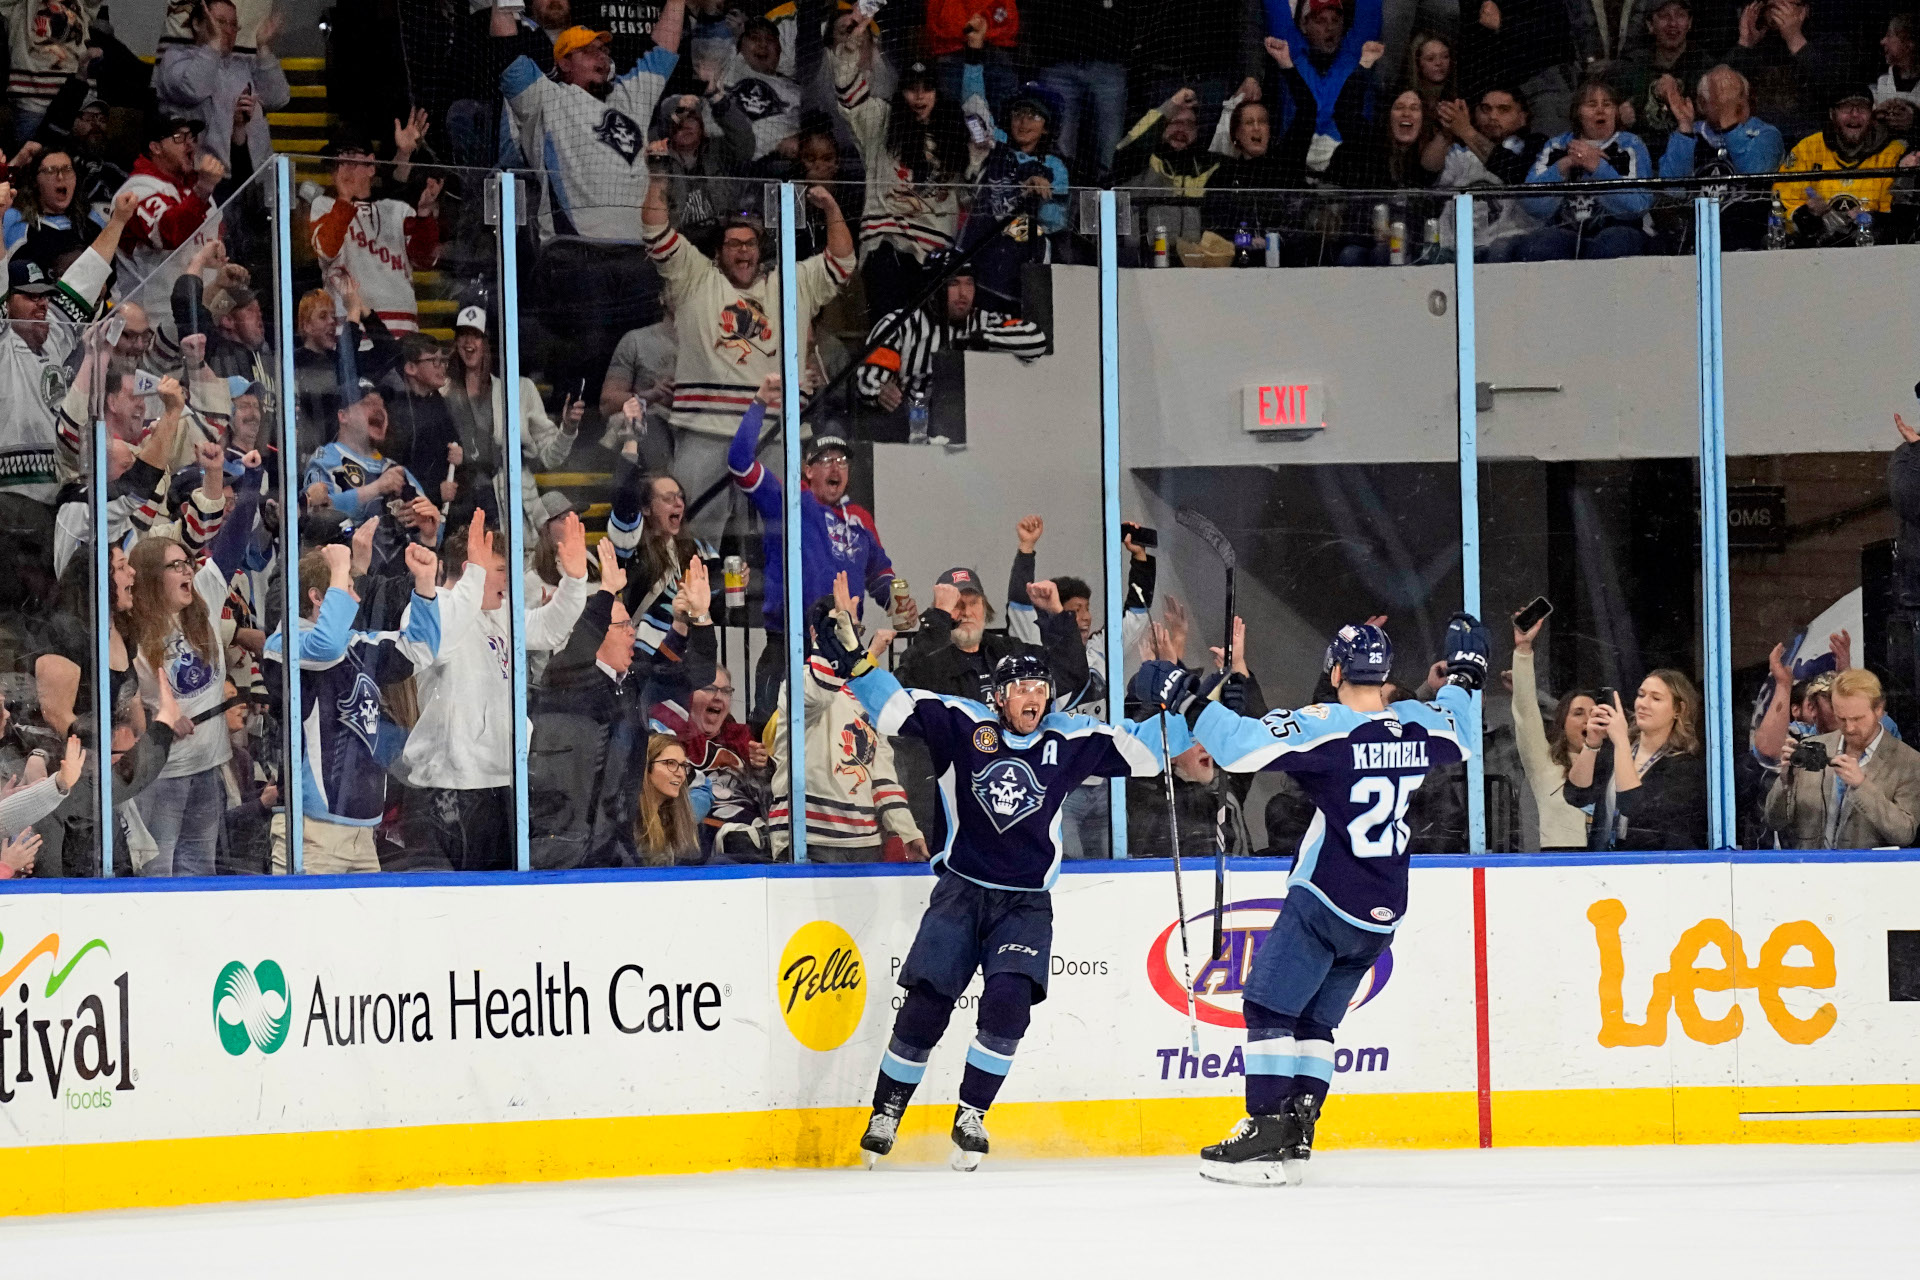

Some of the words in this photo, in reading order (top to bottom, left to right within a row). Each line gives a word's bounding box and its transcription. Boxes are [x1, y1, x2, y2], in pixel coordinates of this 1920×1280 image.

[610, 20, 655, 34] SEASO
[1258, 385, 1309, 426] EXIT
[1368, 652, 1383, 664] 25
[1040, 738, 1058, 766] A
[1351, 741, 1430, 770] KEMELL
[1002, 766, 1017, 782] A
[1346, 773, 1426, 859] 25
[1050, 955, 1109, 976] Doors
[1586, 898, 1838, 1048] Lee
[783, 947, 861, 1015] Pella
[303, 974, 434, 1047] Aurora
[448, 960, 590, 1040] Health
[608, 963, 723, 1034] Care
[65, 1085, 112, 1110] foods
